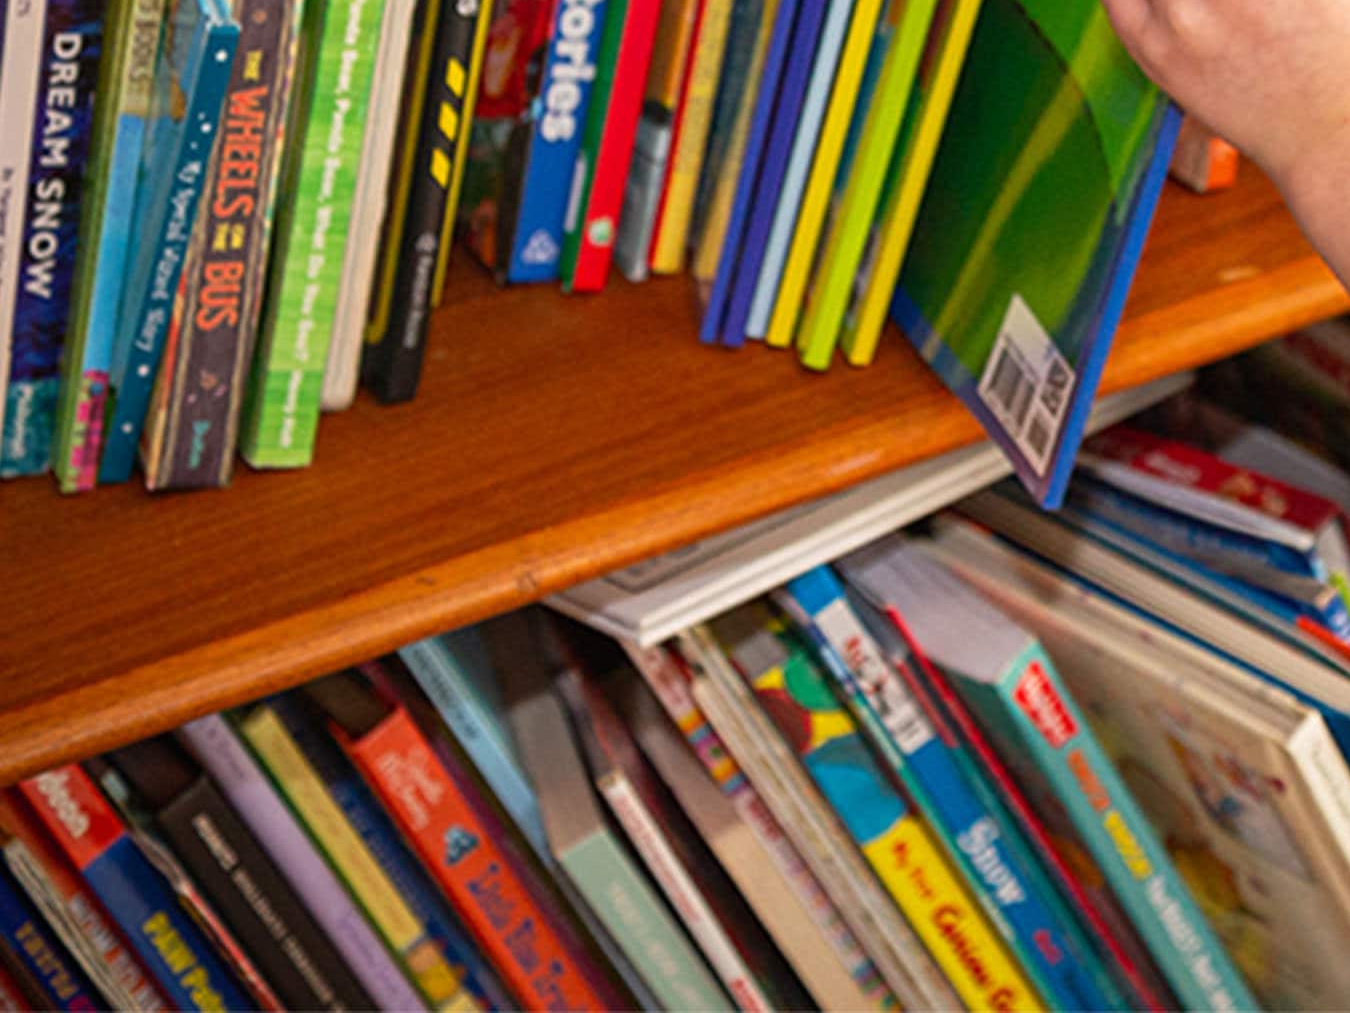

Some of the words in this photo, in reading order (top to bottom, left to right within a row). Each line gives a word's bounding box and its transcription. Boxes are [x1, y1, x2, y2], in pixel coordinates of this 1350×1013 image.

[37, 29, 82, 168] DREAM
[212, 80, 270, 223] WHEELS
[24, 176, 64, 300] SNOW
[195, 255, 244, 336] BUS
